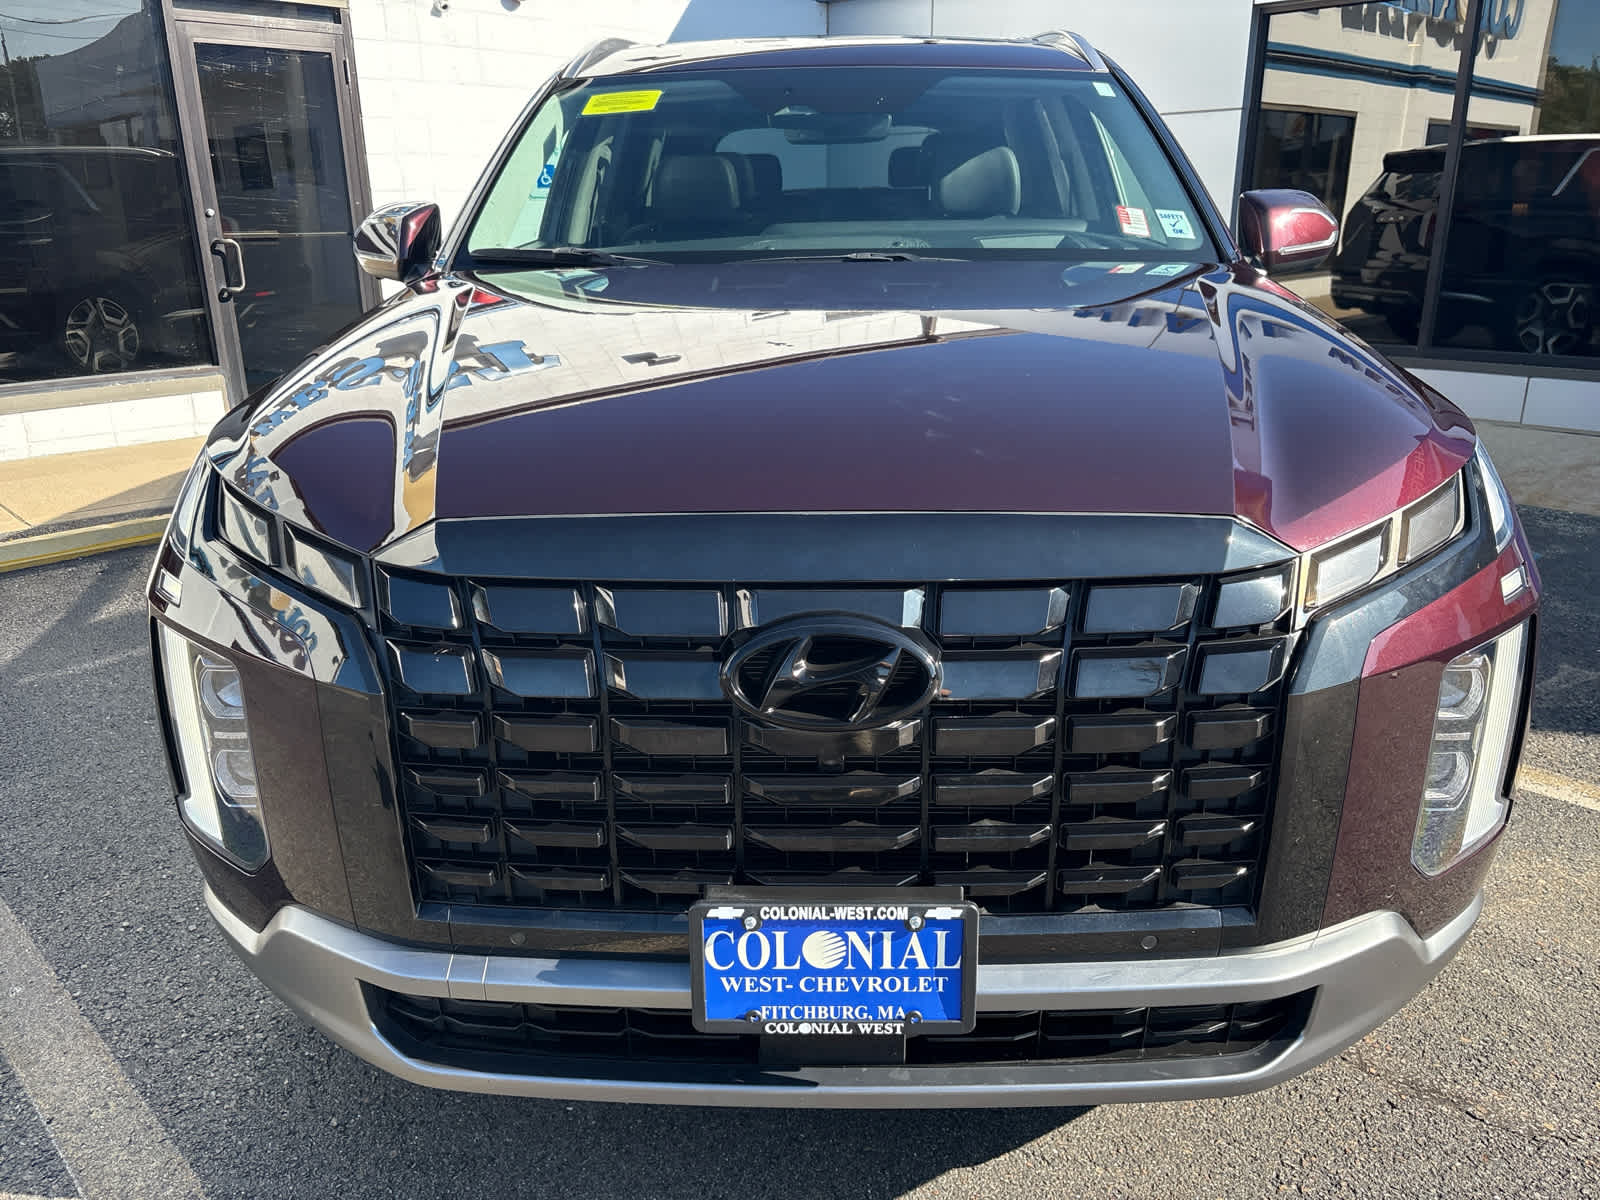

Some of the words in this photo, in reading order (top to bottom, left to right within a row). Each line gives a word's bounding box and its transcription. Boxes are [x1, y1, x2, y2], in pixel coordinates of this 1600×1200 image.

[760, 906, 908, 920] COLONIAL-WEST.COM
[704, 930, 962, 970] COLONIAL
[720, 977, 793, 992] WEST-
[800, 977, 948, 992] CHEVROLET
[761, 1005, 873, 1021] FITCHBURG,
[878, 1005, 905, 1020] MA
[765, 1023, 853, 1034] COLONIAL
[860, 1023, 904, 1034] WEST
